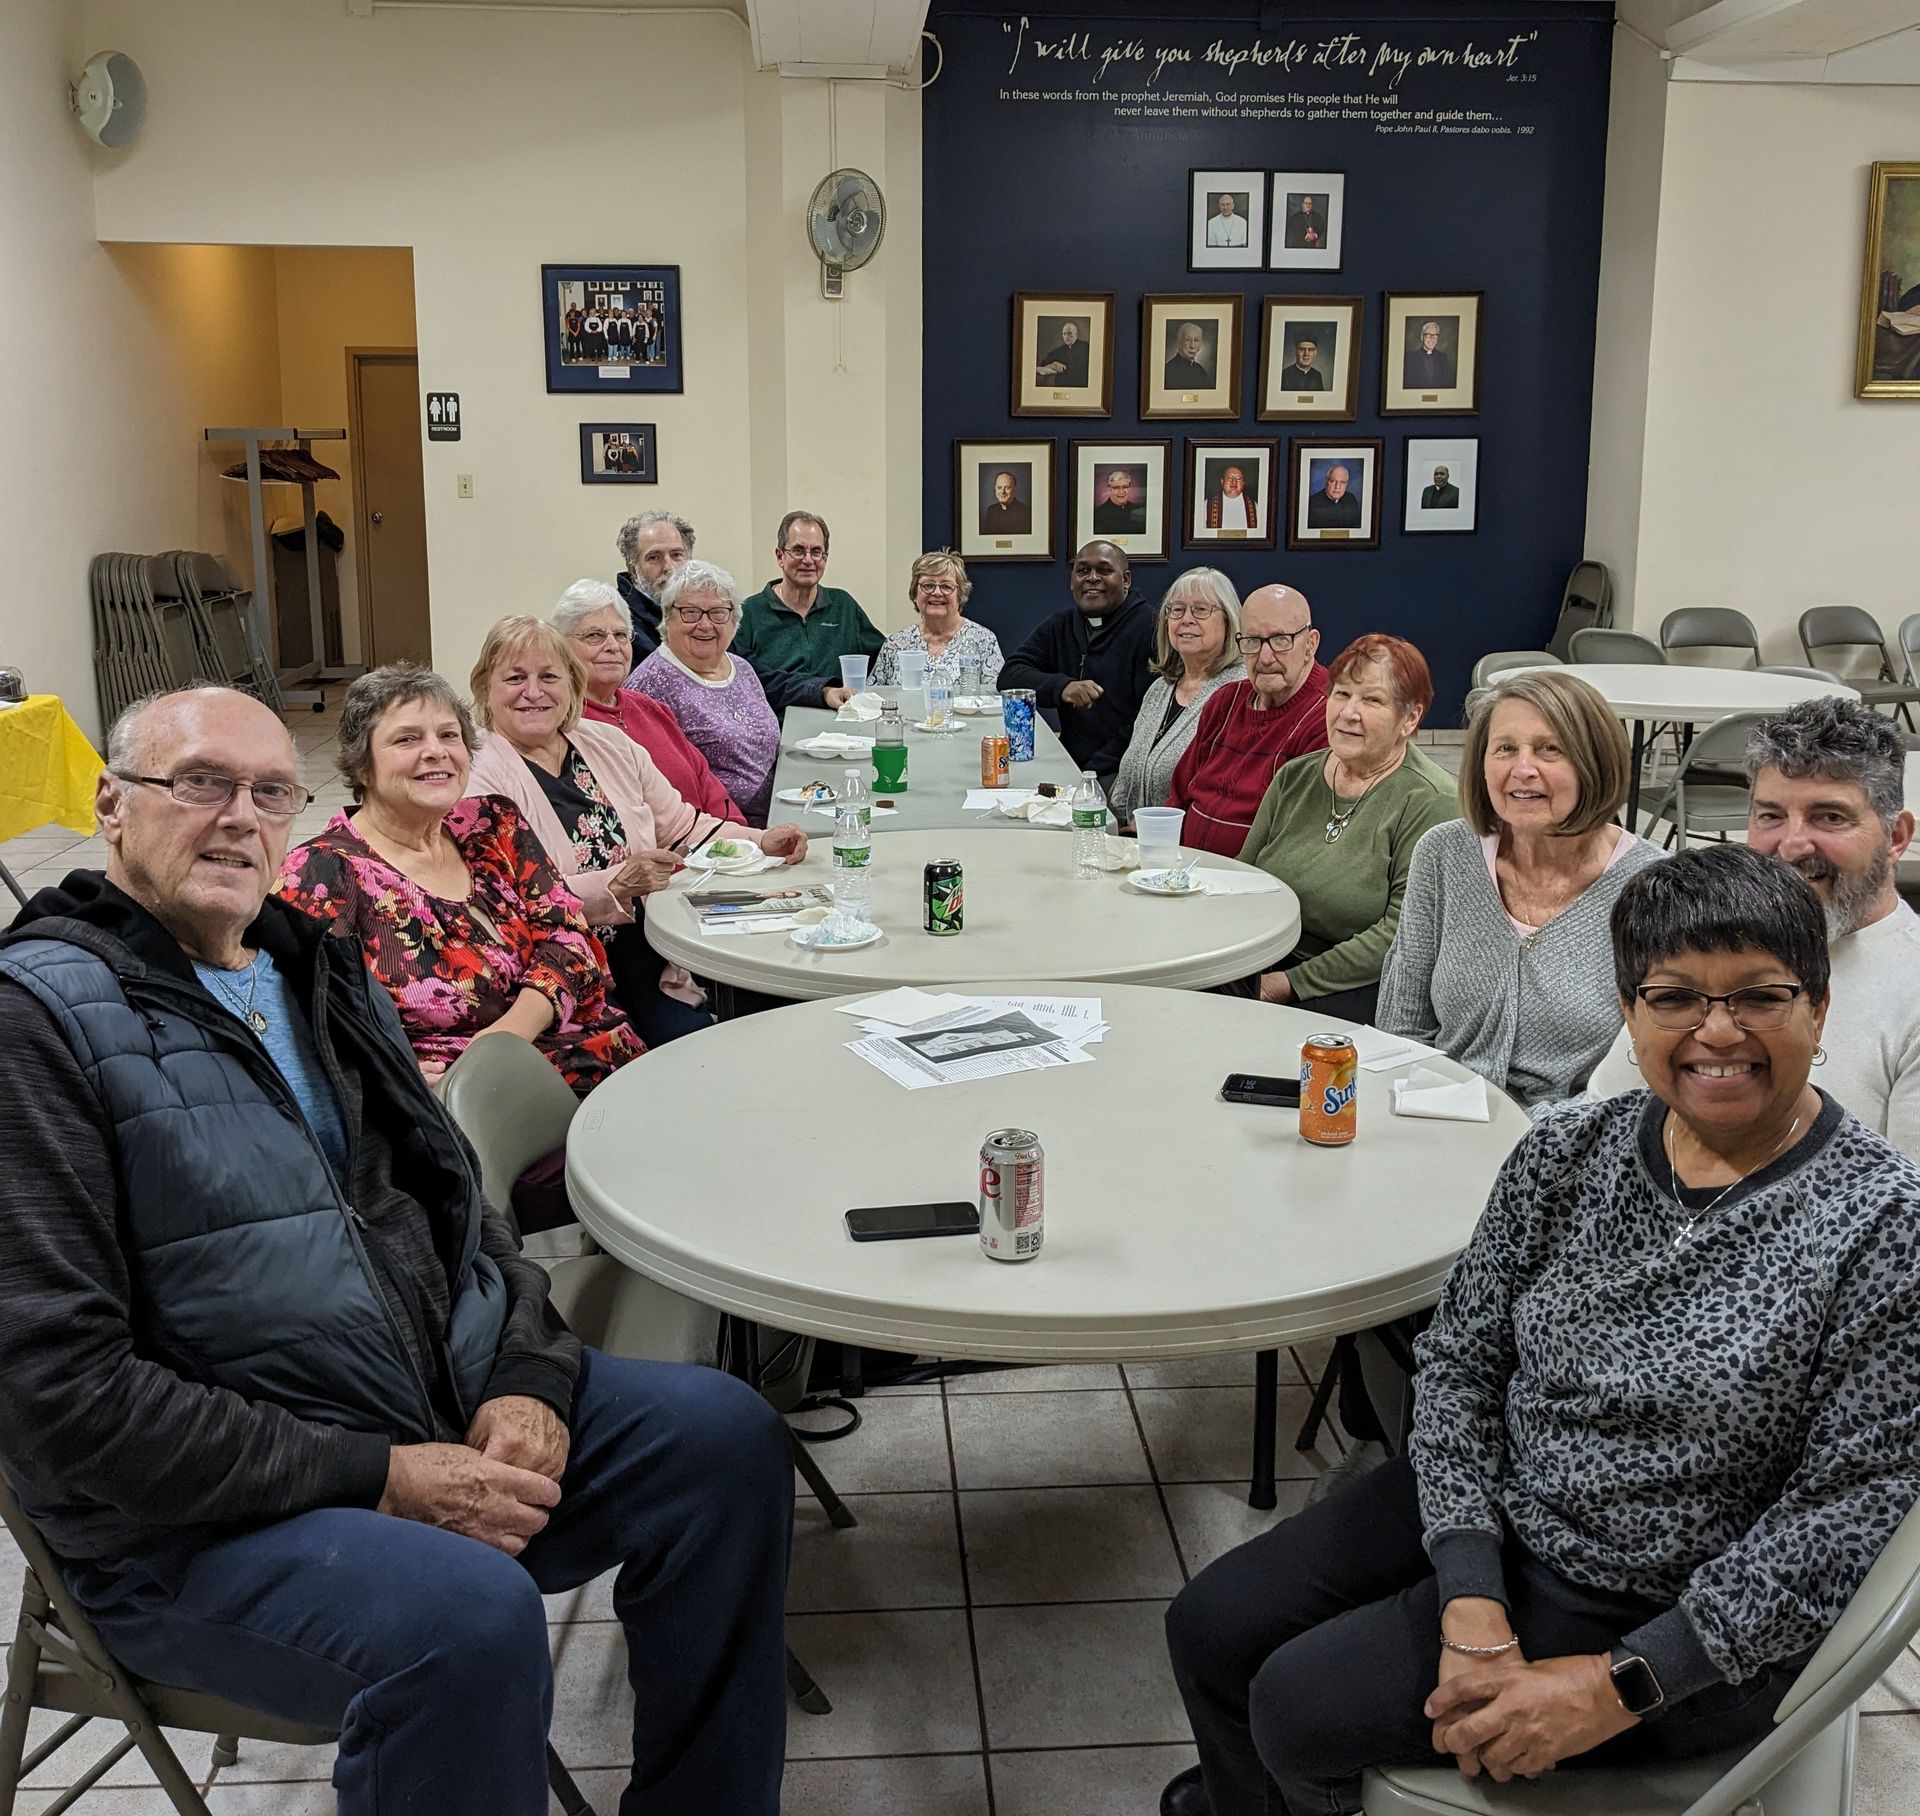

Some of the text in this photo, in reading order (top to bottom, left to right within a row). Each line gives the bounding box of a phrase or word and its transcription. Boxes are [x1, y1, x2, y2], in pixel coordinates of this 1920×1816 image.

[1035, 33, 1090, 59] will
[1093, 40, 1144, 83] give
[1147, 47, 1194, 86] you
[1201, 40, 1307, 75] shepherds
[1313, 33, 1366, 69] after
[1418, 47, 1459, 65] own
[1505, 73, 1537, 82] Jer. 3:15
[999, 88, 1398, 106] In these words from the prophet Jeremiah, God promises His people that He will
[1114, 107, 1142, 116] never
[1144, 105, 1170, 117] leave
[1172, 105, 1199, 117] them
[1200, 106, 1238, 117] without
[1240, 106, 1292, 120] shepherds
[1294, 108, 1305, 118] to
[1307, 108, 1340, 121] gather
[1342, 108, 1368, 119] them
[1370, 108, 1413, 122] together
[1414, 109, 1434, 120] and
[1435, 109, 1464, 123] guide
[1375, 124, 1394, 134] Pope
[1394, 125, 1414, 133] John
[1414, 125, 1432, 133] Paul
[1439, 125, 1470, 134] Pastores
[1471, 125, 1491, 134] dabo
[1516, 126, 1535, 134] 1992
